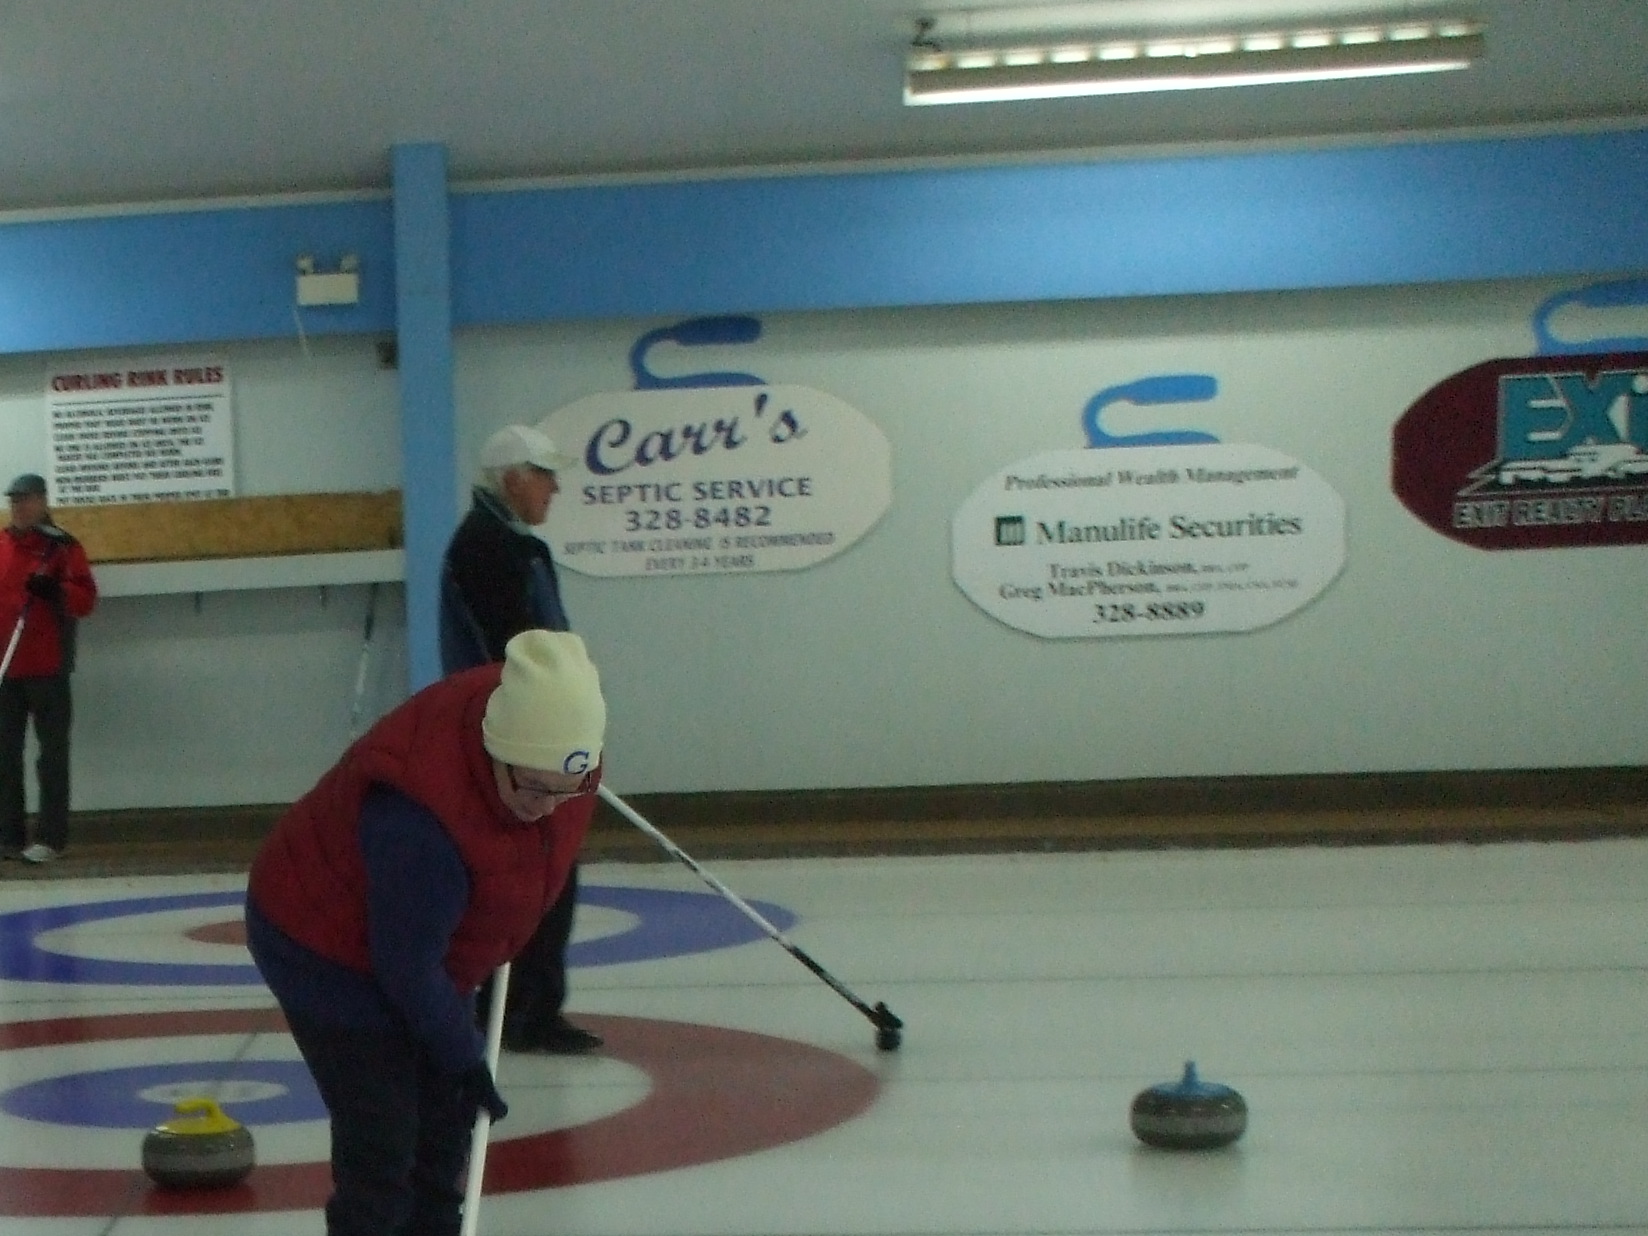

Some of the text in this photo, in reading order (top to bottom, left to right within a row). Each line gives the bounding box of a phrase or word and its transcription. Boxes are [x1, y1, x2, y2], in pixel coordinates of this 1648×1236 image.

[52, 366, 224, 392] CURLING RINK RULES
[583, 392, 809, 476] Carr's
[1003, 465, 1300, 491] Professional Wealth Management
[583, 477, 812, 506] SEPTIC SERVICE
[625, 506, 773, 532] 328-8482
[1036, 511, 1302, 546] Manulife Securities
[611, 536, 645, 553] TANK
[1047, 562, 1104, 579] Travis
[998, 582, 1044, 602] Greg
[1092, 602, 1206, 624] 328-8889
